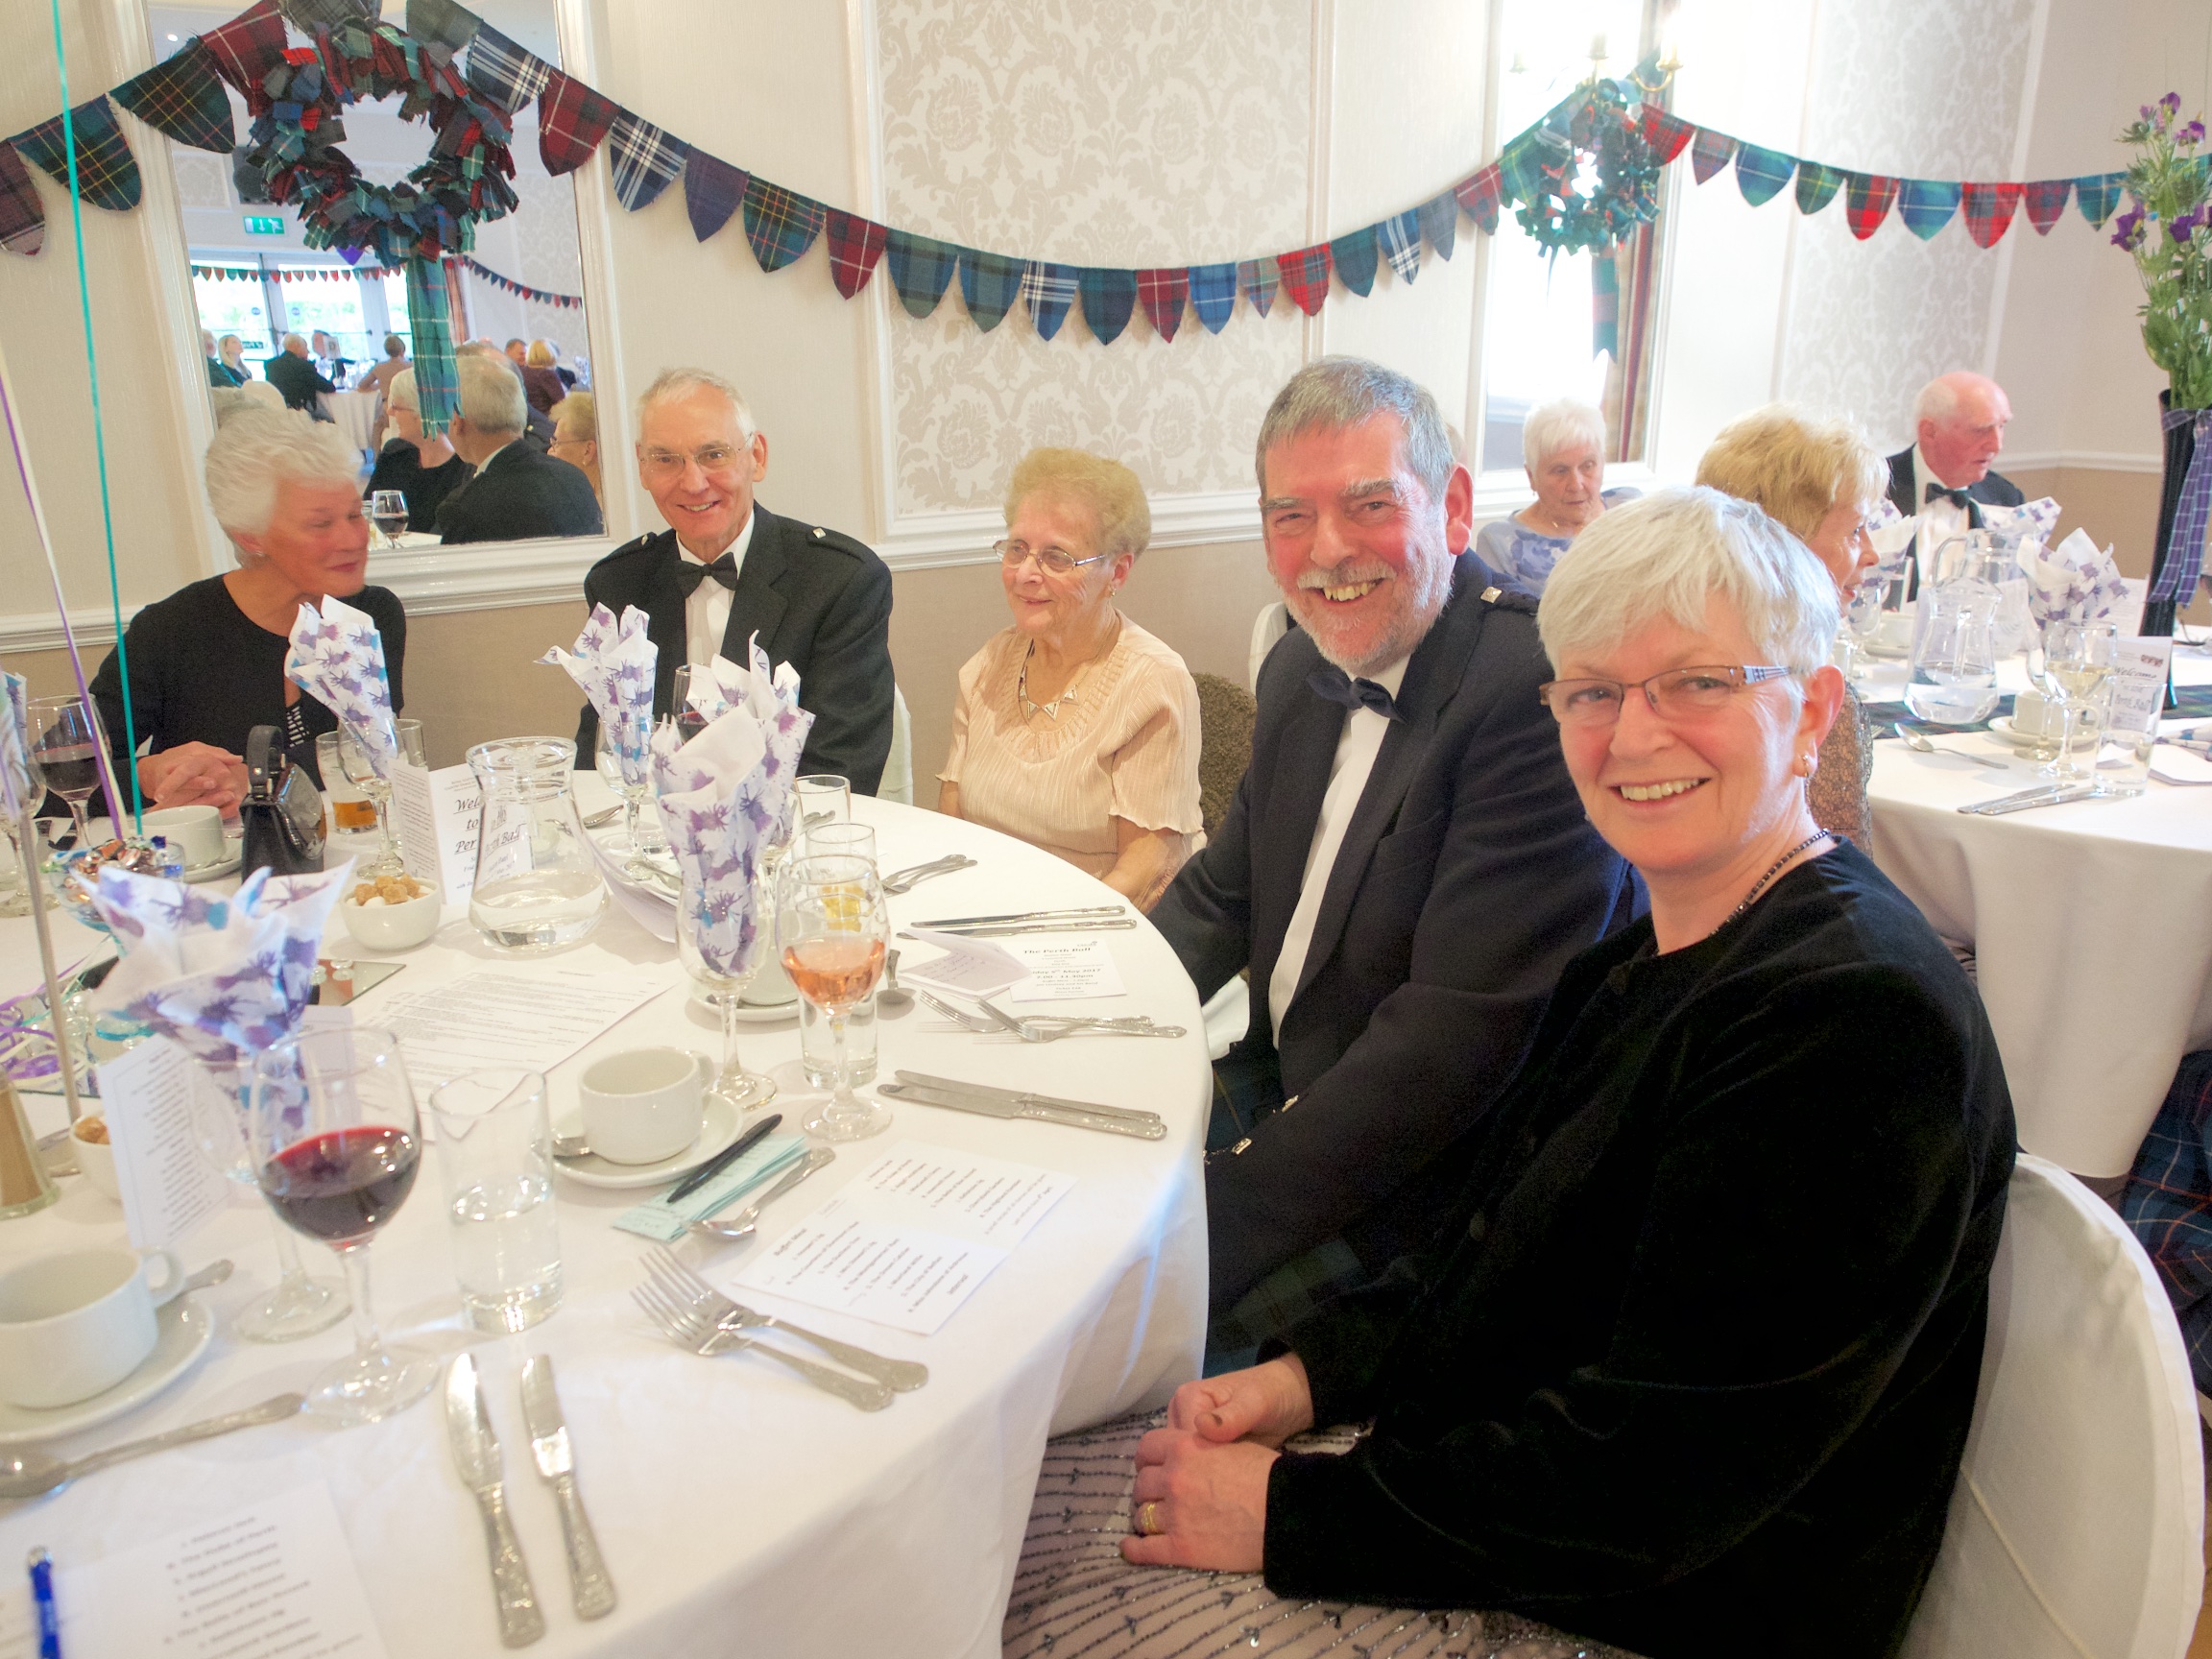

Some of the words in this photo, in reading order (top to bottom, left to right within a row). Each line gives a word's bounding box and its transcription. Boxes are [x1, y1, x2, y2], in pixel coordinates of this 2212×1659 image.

[455, 796, 480, 812] Wel
[467, 818, 478, 830] to
[456, 839, 476, 854] Per
